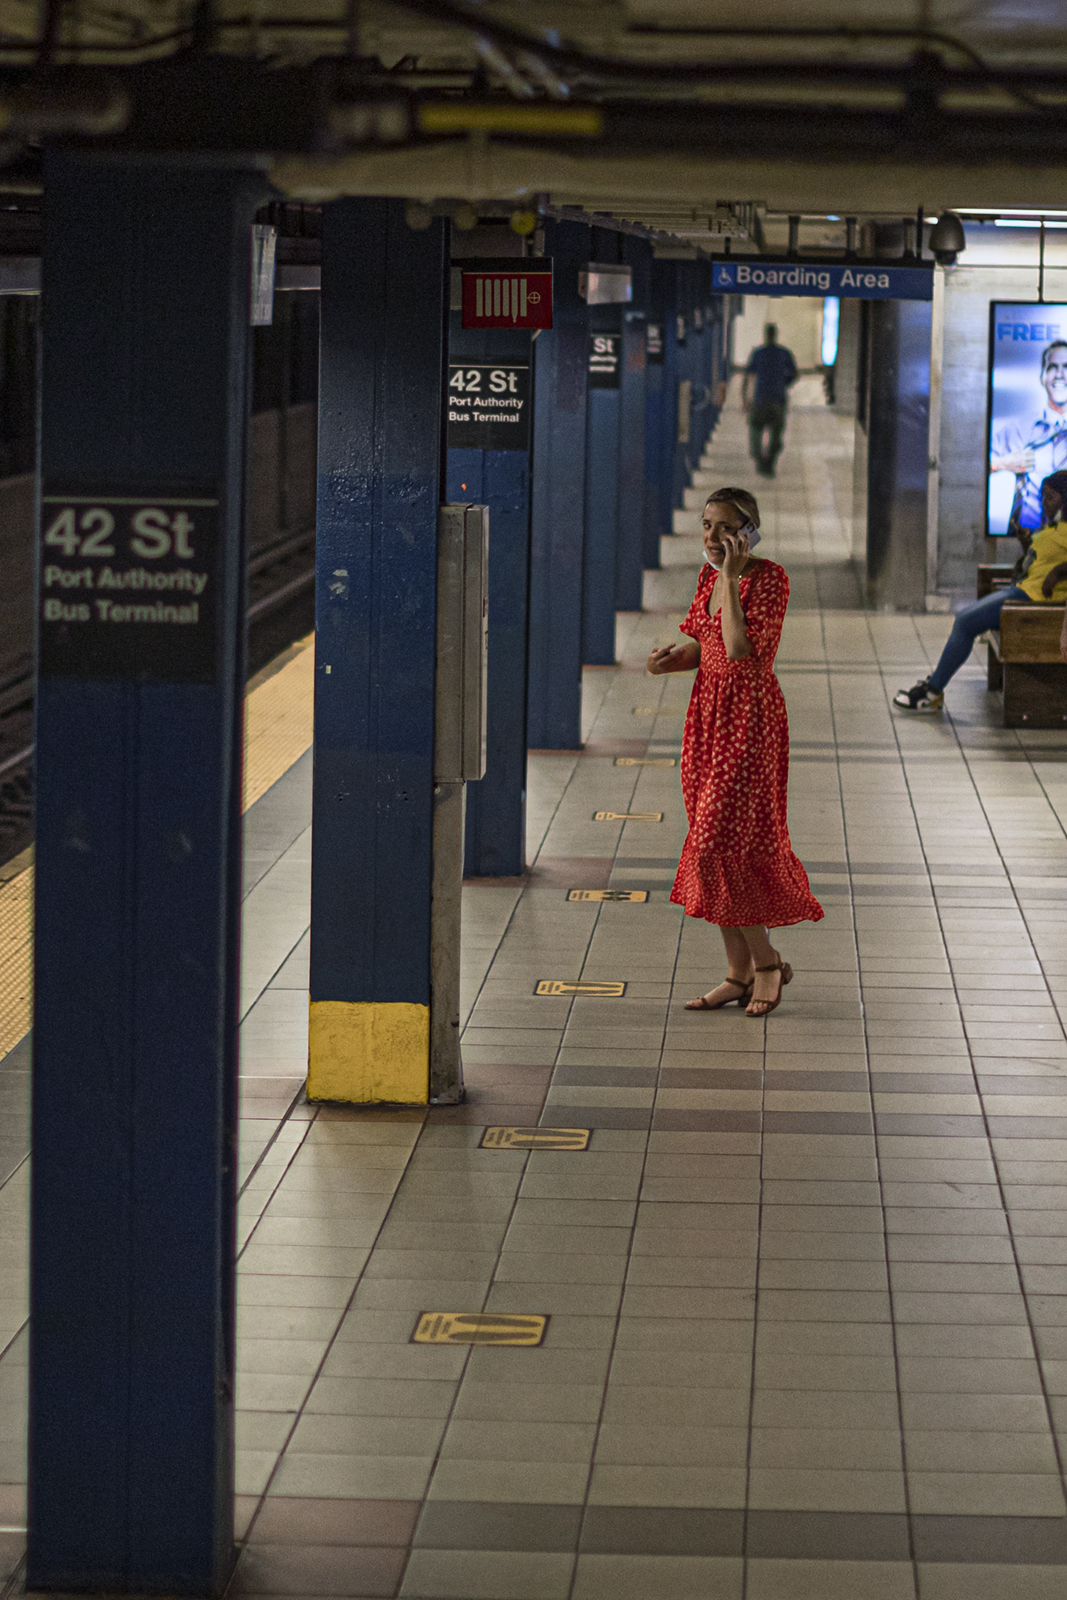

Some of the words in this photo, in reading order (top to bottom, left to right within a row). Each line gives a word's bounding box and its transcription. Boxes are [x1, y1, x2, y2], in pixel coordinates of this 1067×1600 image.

[736, 266, 830, 289] Boarding
[840, 269, 890, 289] Area
[594, 337, 613, 353] St
[449, 370, 482, 392] 42
[489, 370, 518, 393] St
[449, 396, 471, 407] Port
[474, 396, 524, 409] Authority
[449, 411, 470, 421] Bus
[472, 411, 520, 423] Terminal
[44, 507, 115, 556] 42
[131, 507, 195, 559] St
[44, 565, 93, 588] Port
[98, 566, 208, 595] Authority
[44, 599, 91, 622] Bus
[95, 599, 199, 624] Terminal
